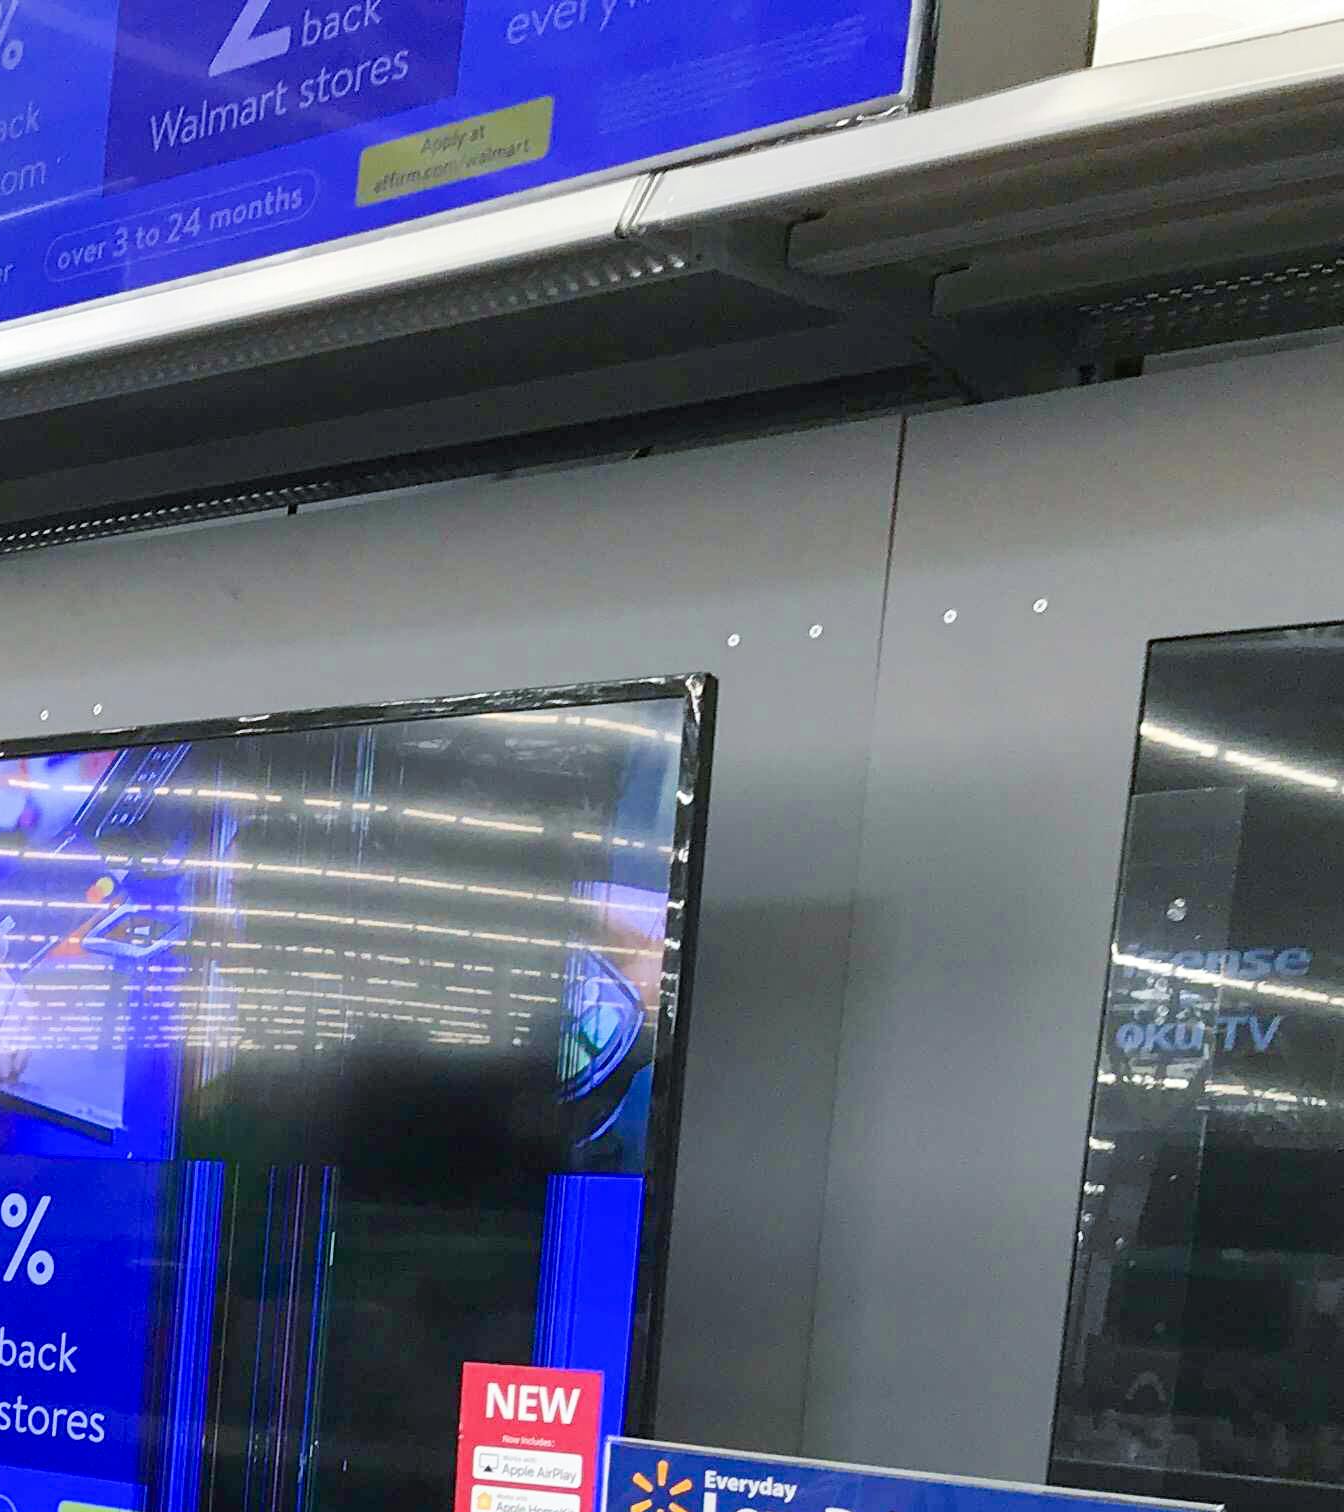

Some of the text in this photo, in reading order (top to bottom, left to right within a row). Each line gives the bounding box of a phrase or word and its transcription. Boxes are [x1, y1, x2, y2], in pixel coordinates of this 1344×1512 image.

[302, 0, 382, 47] back
[149, 48, 410, 154] Walmart stores
[420, 123, 486, 159] Apply at
[56, 186, 303, 271] over 3 to 24 months
[484, 1382, 581, 1425] NEW
[502, 1463, 577, 1484] Apple AirPlay
[704, 1470, 798, 1503] Everyday
